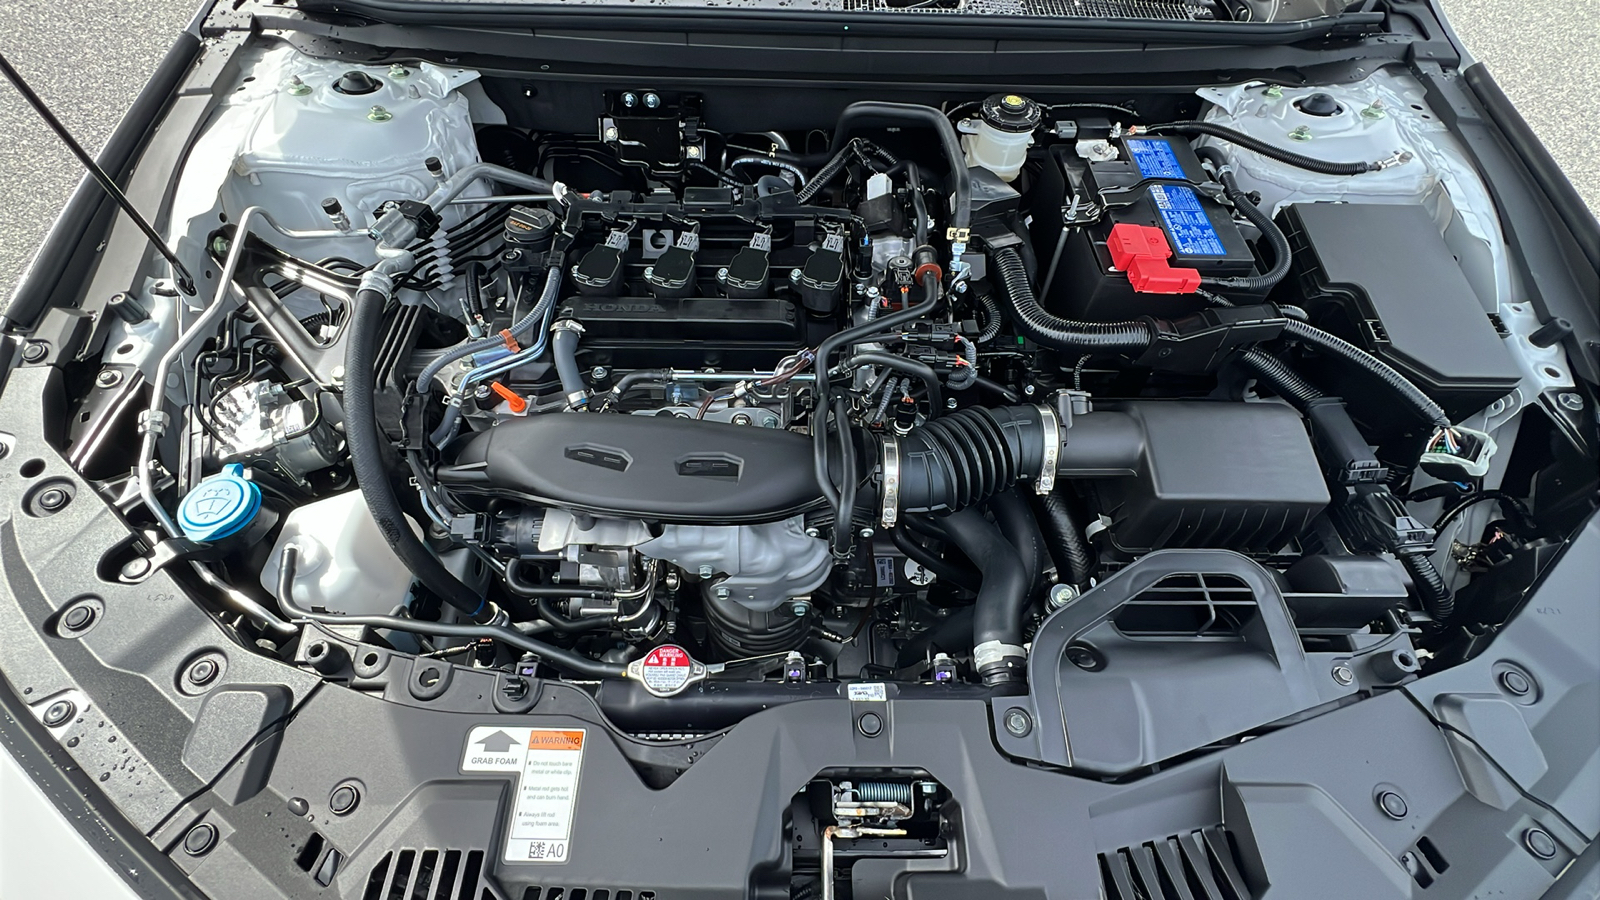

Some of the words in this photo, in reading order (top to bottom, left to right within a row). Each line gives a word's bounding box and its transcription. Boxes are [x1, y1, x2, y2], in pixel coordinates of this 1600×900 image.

[583, 303, 666, 312] HONDA
[541, 736, 580, 745] WARNING
[471, 757, 493, 765] GRAB
[546, 843, 564, 858] A0
